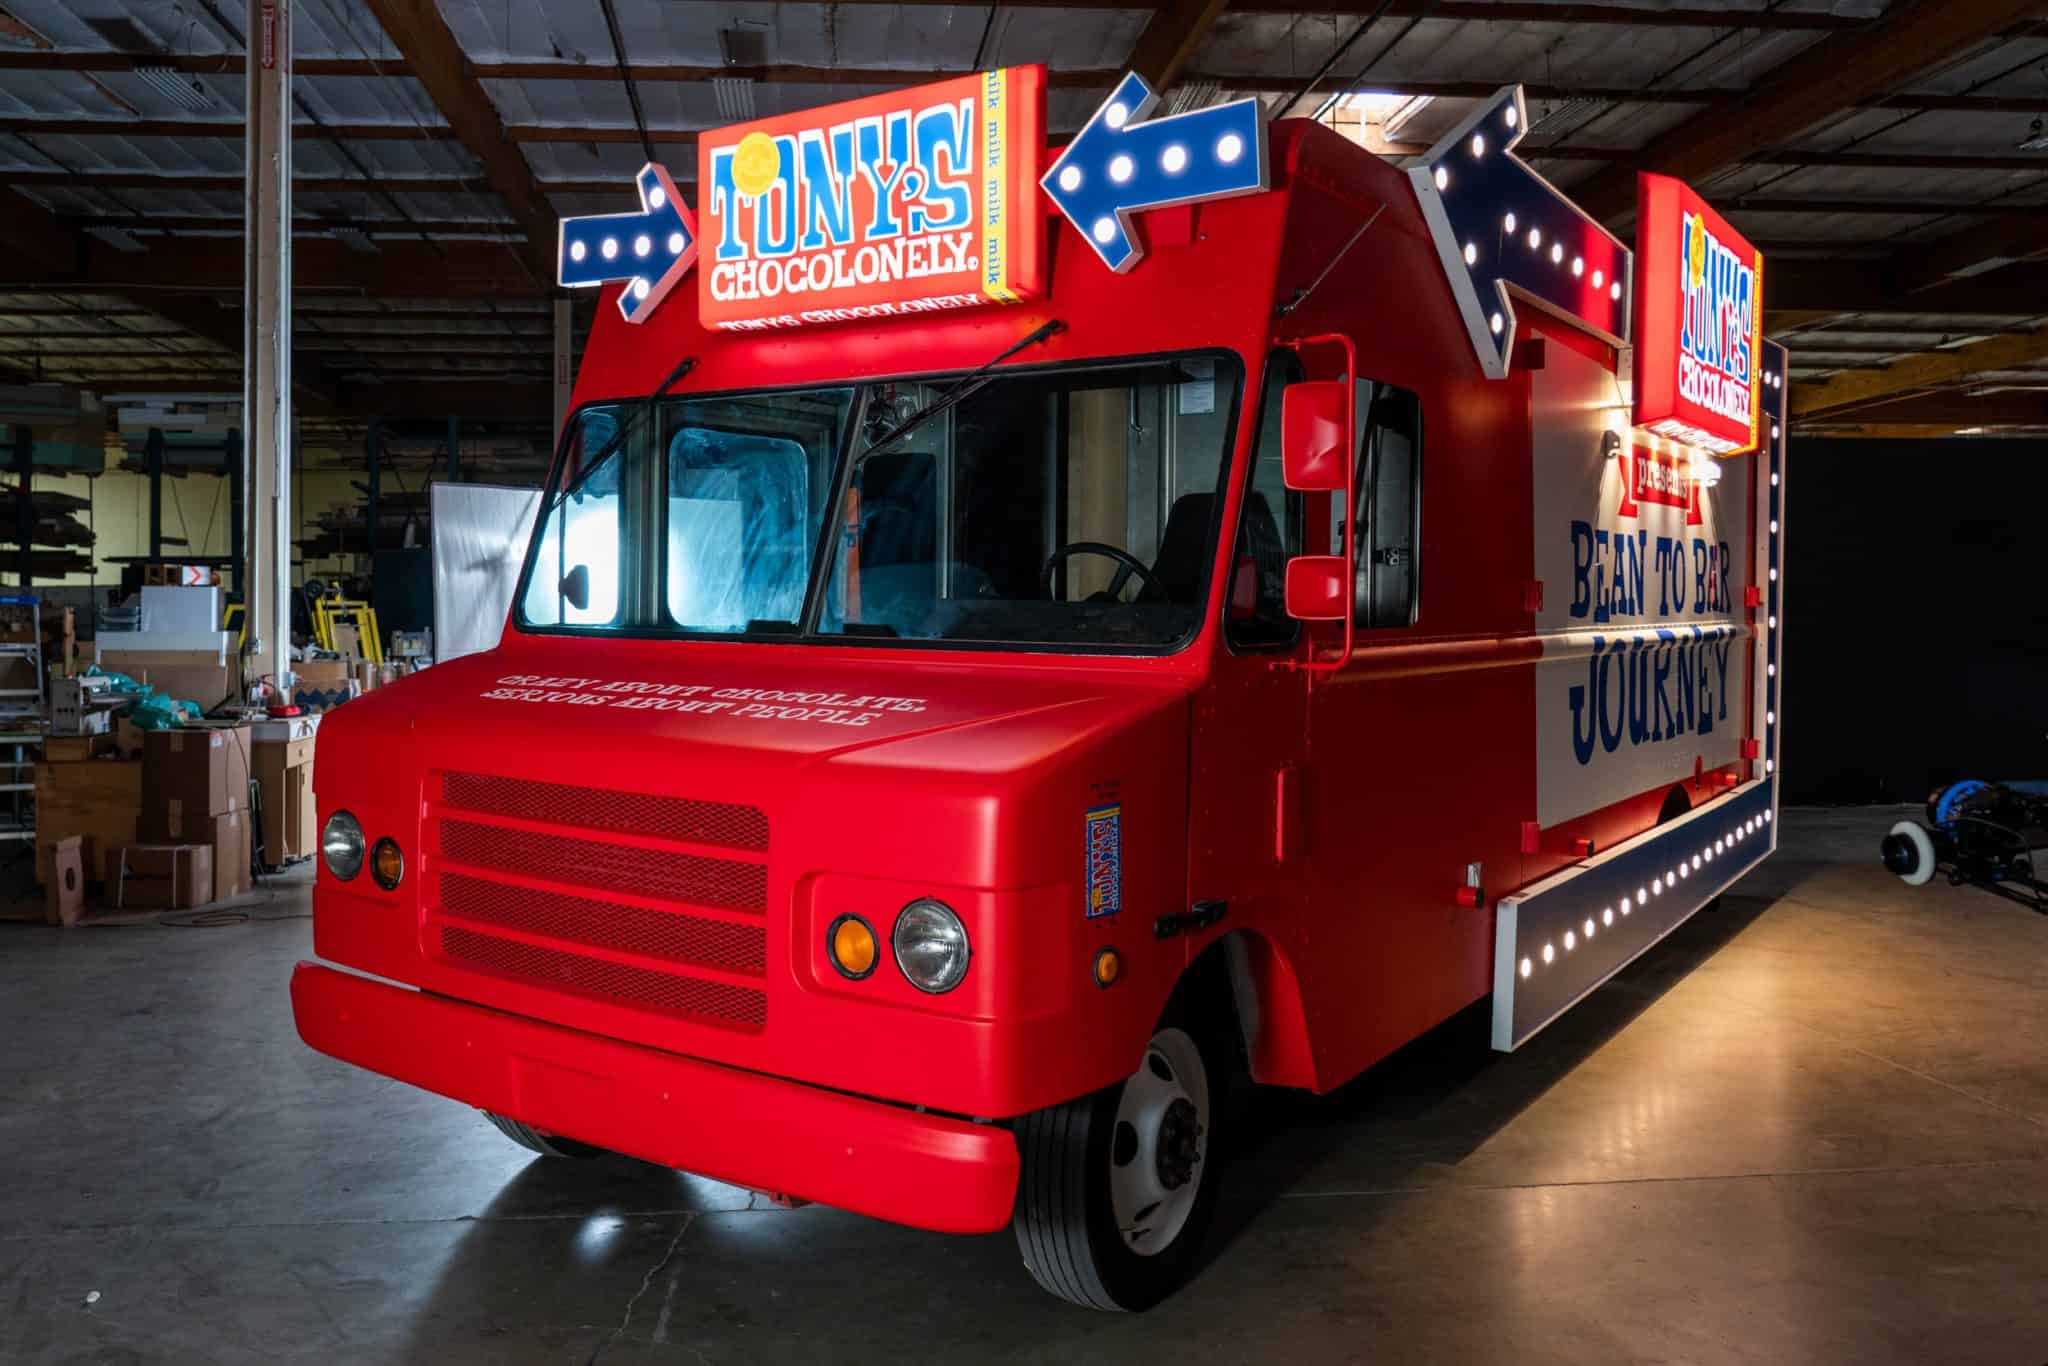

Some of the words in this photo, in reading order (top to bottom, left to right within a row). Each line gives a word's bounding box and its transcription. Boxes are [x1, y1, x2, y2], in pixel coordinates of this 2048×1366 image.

[988, 121, 1001, 168] milk
[710, 98, 975, 261] TONY'S
[988, 180, 1001, 226] milk
[988, 238, 1001, 285] milk
[1682, 211, 1753, 386] TONY'S
[1570, 520, 1647, 623] BEAN
[1656, 537, 1686, 616] TO
[1693, 538, 1732, 614] BAR
[480, 688, 617, 705] SERIOUS
[608, 696, 737, 714] ABOUT
[728, 702, 884, 726] PEOPLE
[496, 675, 600, 689] CRAZY
[592, 682, 713, 697] ABOUT
[1569, 624, 1738, 765] JOURNEY
